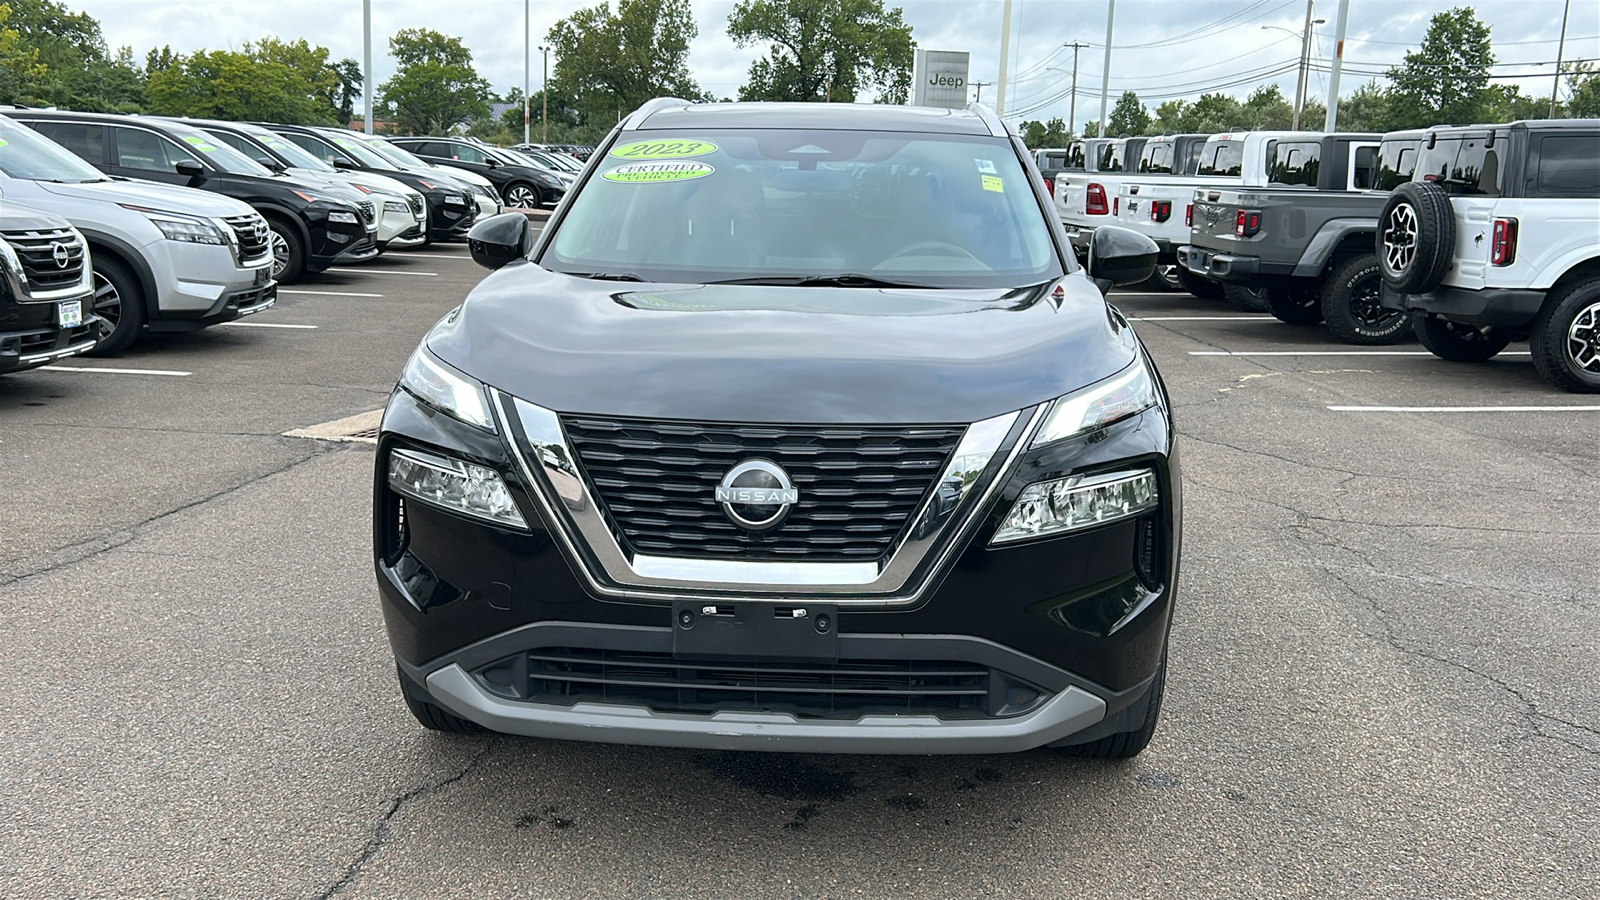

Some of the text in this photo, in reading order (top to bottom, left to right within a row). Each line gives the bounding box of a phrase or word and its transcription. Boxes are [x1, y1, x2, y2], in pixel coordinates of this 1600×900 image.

[929, 73, 964, 89] Jeep
[623, 143, 702, 156] 2023
[616, 164, 704, 174] CERTIFIED
[718, 490, 795, 502] NISSAN
